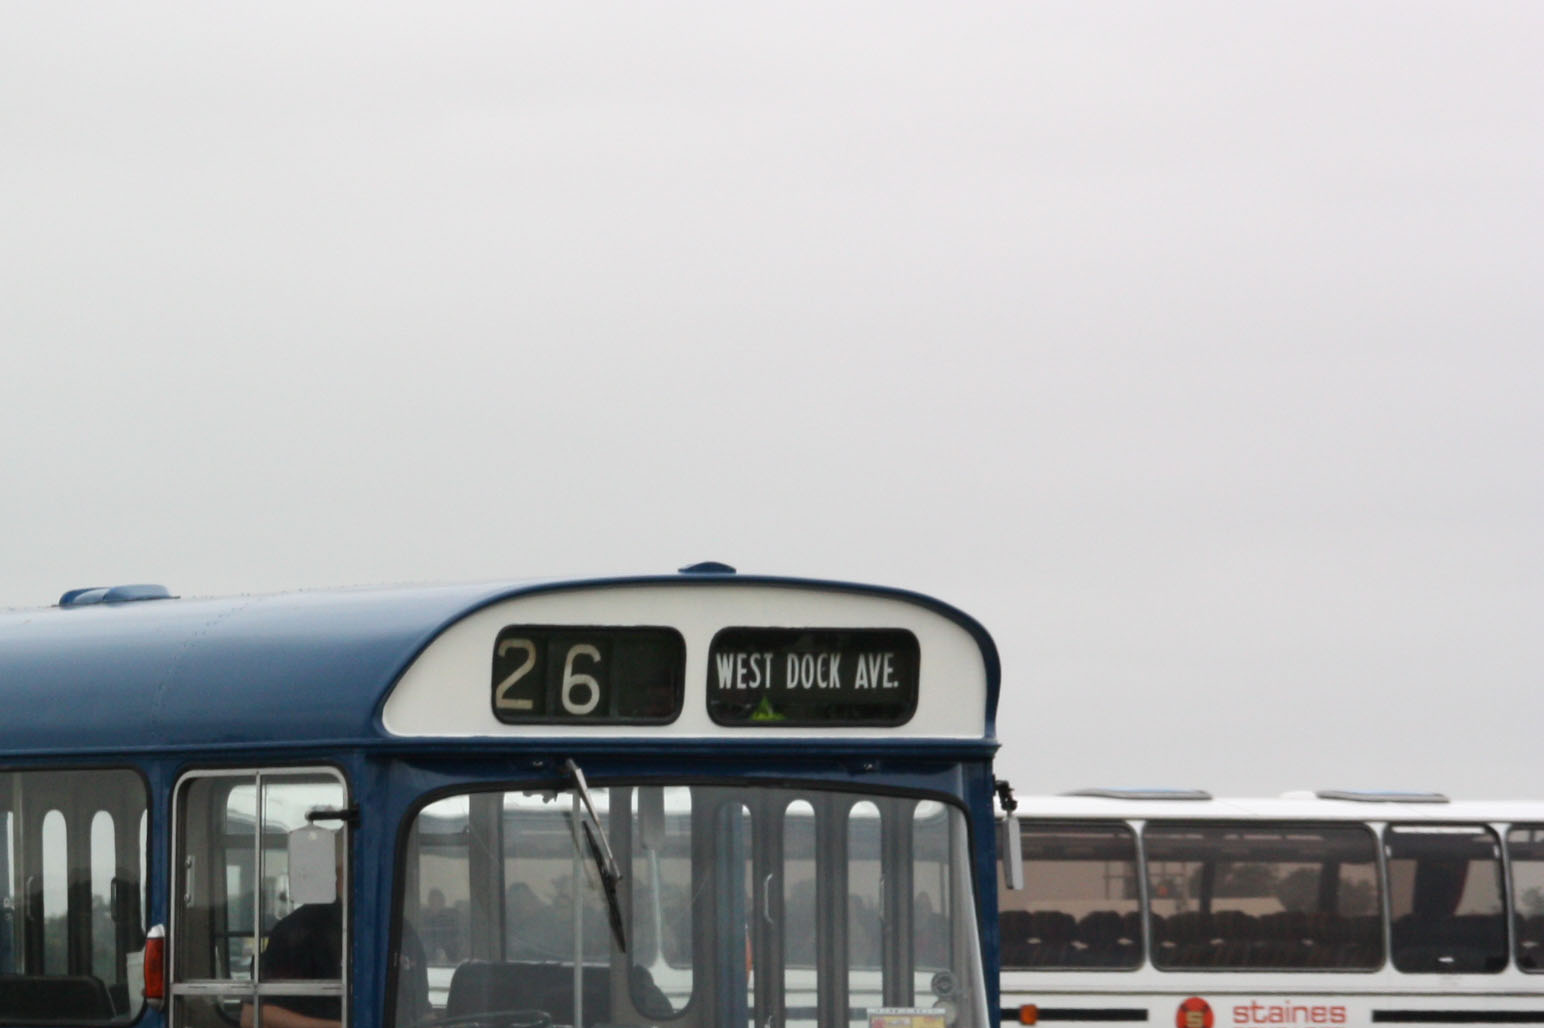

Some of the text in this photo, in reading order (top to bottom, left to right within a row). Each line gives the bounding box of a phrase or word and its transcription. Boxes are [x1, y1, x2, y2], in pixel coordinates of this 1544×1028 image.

[716, 652, 899, 689] WEST DOCK AVE.
[1232, 1000, 1347, 1024] staines
